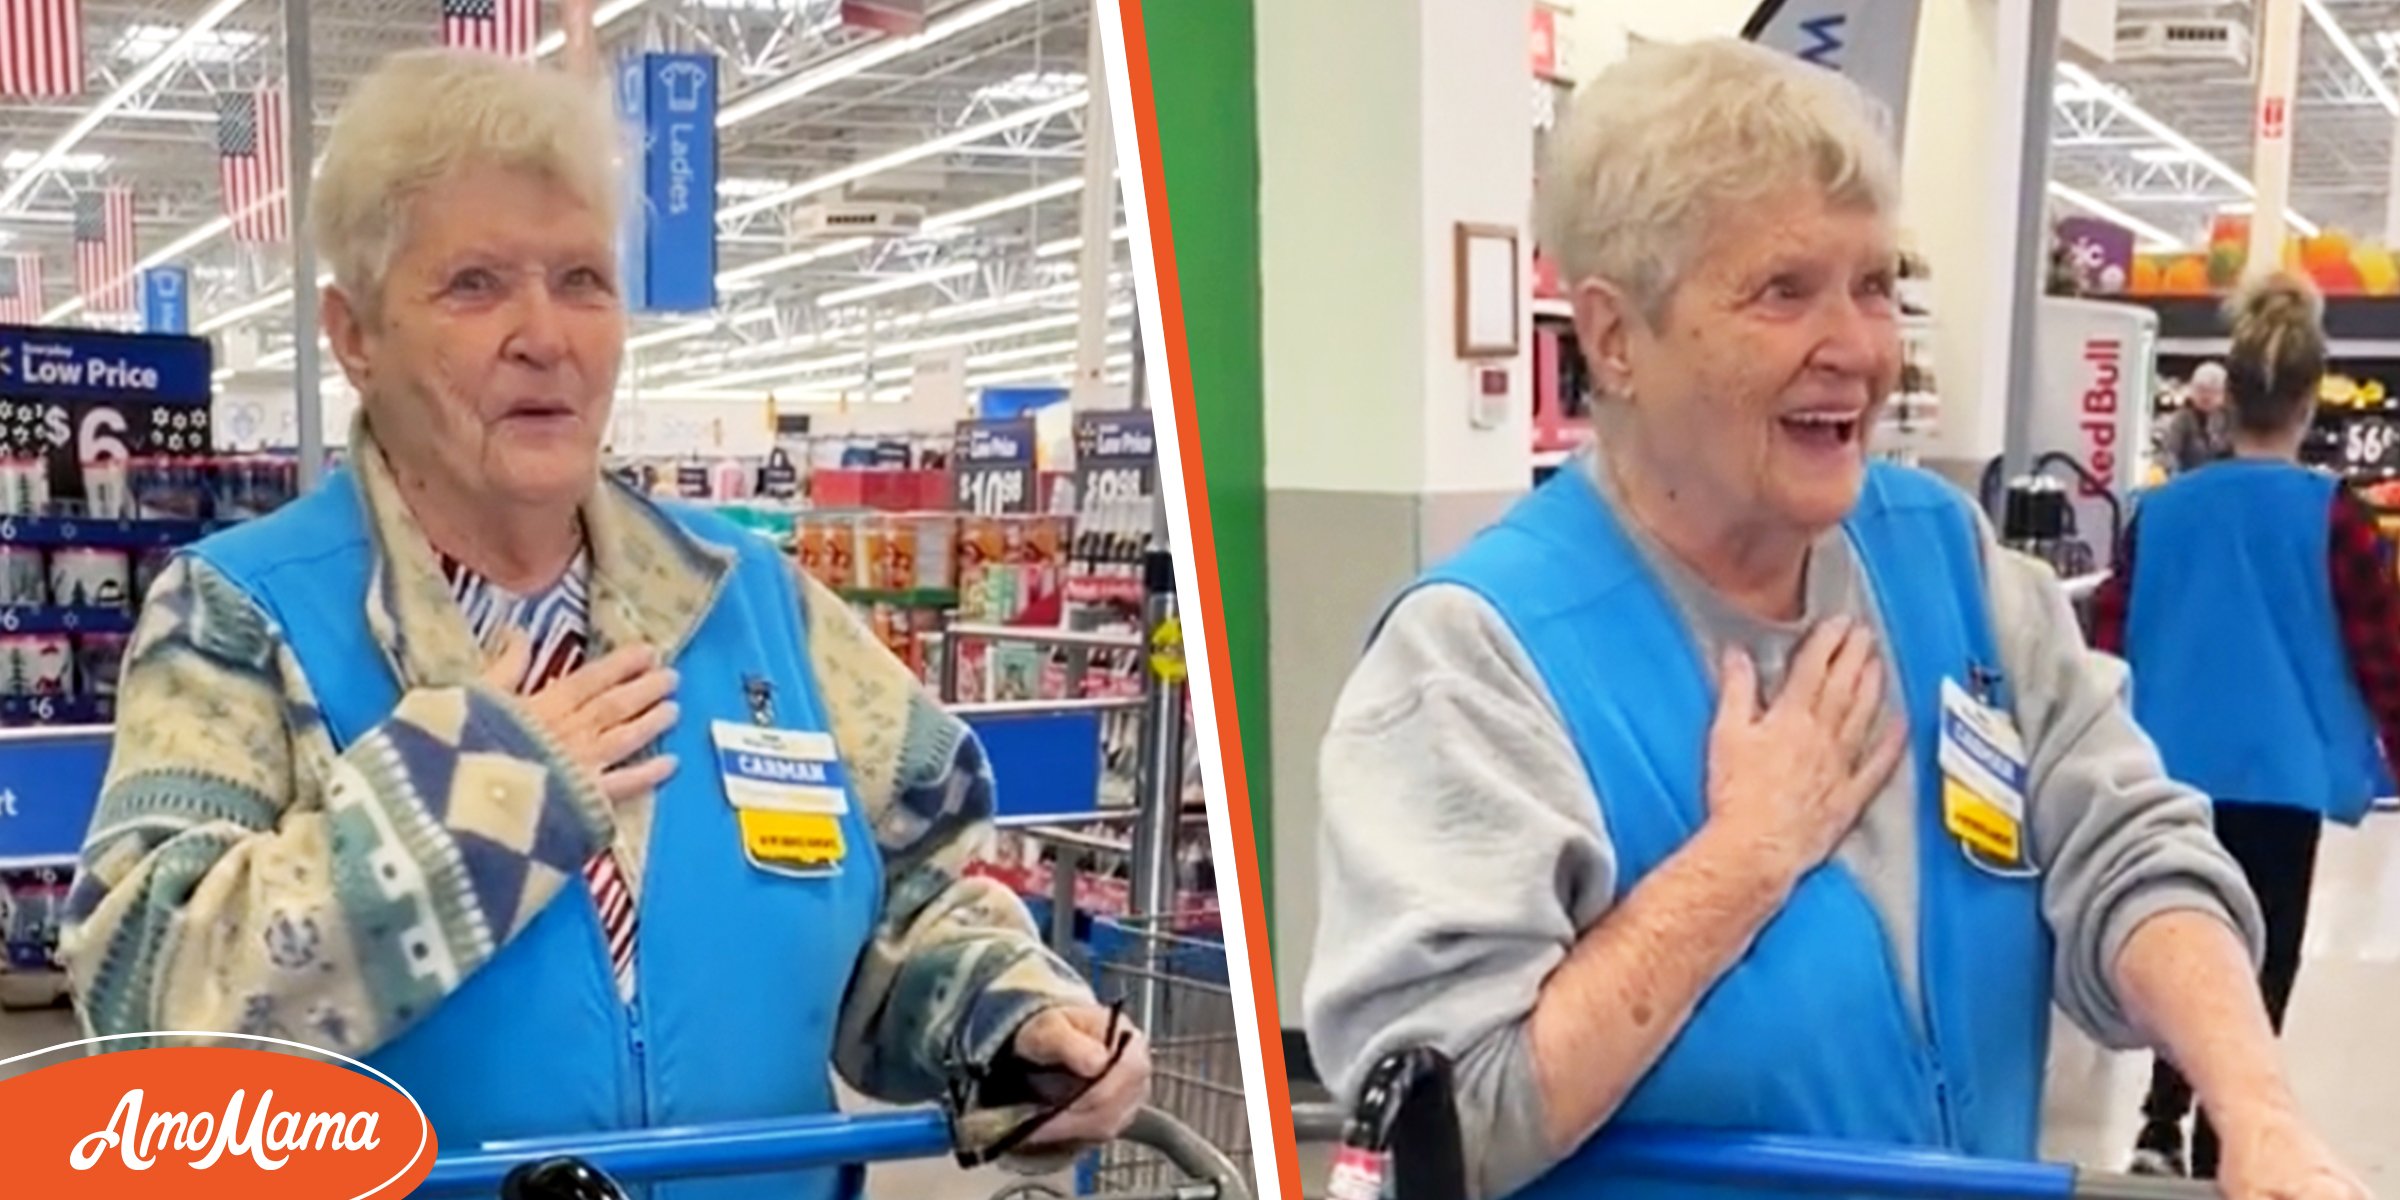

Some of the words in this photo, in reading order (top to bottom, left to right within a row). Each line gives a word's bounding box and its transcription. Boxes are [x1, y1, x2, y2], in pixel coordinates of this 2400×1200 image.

[670, 122, 694, 214] Ladies
[22, 352, 82, 384] Low
[87, 357, 158, 389] Price
[2083, 339, 2121, 414] Bull
[738, 754, 826, 782] CARMAN
